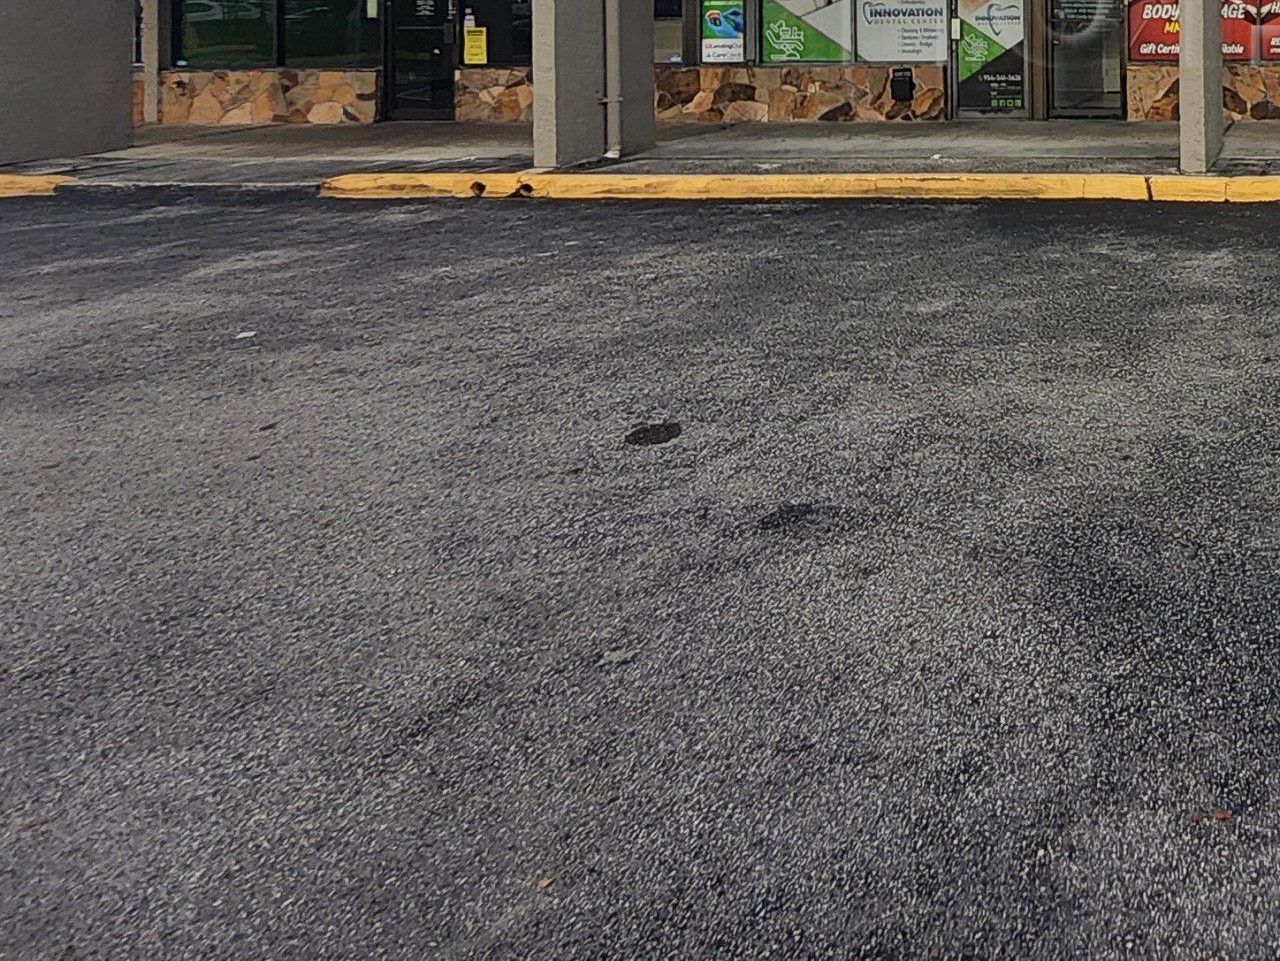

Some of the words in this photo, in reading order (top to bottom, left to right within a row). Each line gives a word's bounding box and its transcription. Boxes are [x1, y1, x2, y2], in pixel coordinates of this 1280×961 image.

[869, 8, 943, 17] INNOVATION
[1143, 4, 1180, 21] BODY
[1140, 44, 1156, 54] Gift
